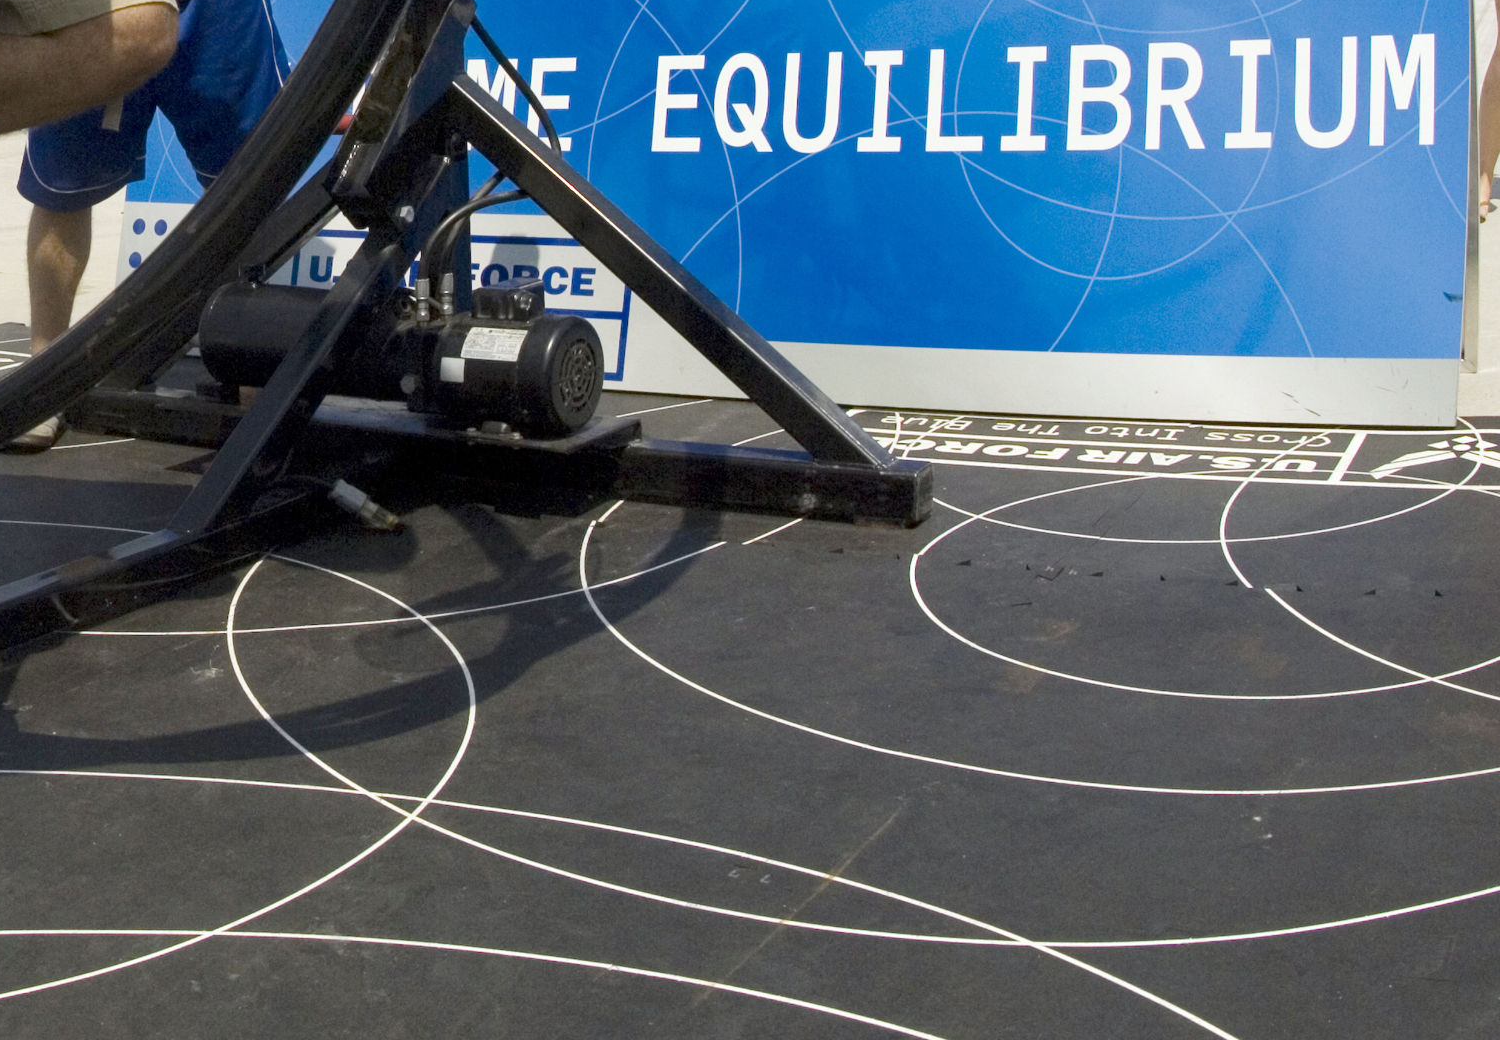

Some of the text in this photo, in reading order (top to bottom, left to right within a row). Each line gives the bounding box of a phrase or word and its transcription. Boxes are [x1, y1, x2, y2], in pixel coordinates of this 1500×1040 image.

[651, 33, 1437, 154] EQUILIBRIUM
[880, 415, 1332, 448] Cross Into The Blue
[1076, 448, 1193, 466] AIR
